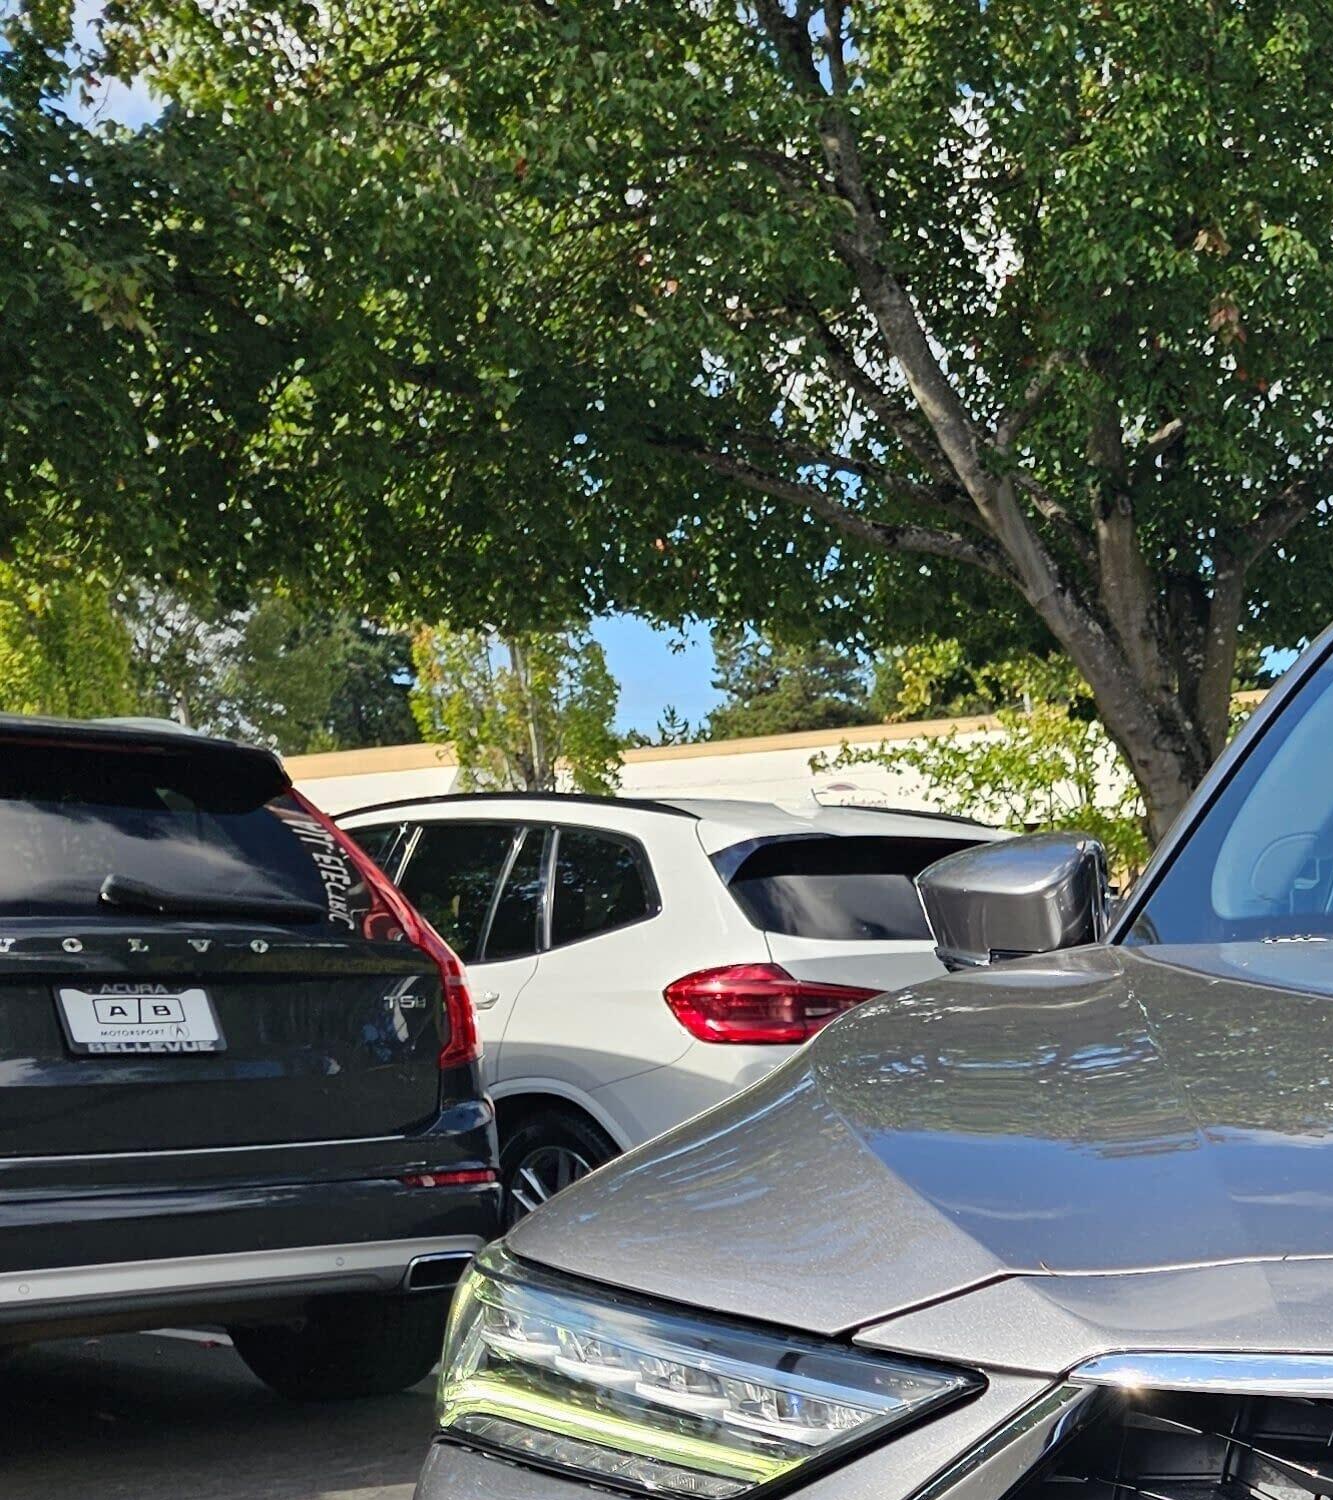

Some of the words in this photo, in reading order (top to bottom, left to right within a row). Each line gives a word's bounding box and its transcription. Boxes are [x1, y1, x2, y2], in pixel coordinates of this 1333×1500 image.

[100, 984, 168, 994] ACURA
[100, 1029, 164, 1037] MOTORSPORT
[87, 1041, 214, 1053] BELLEVUE
